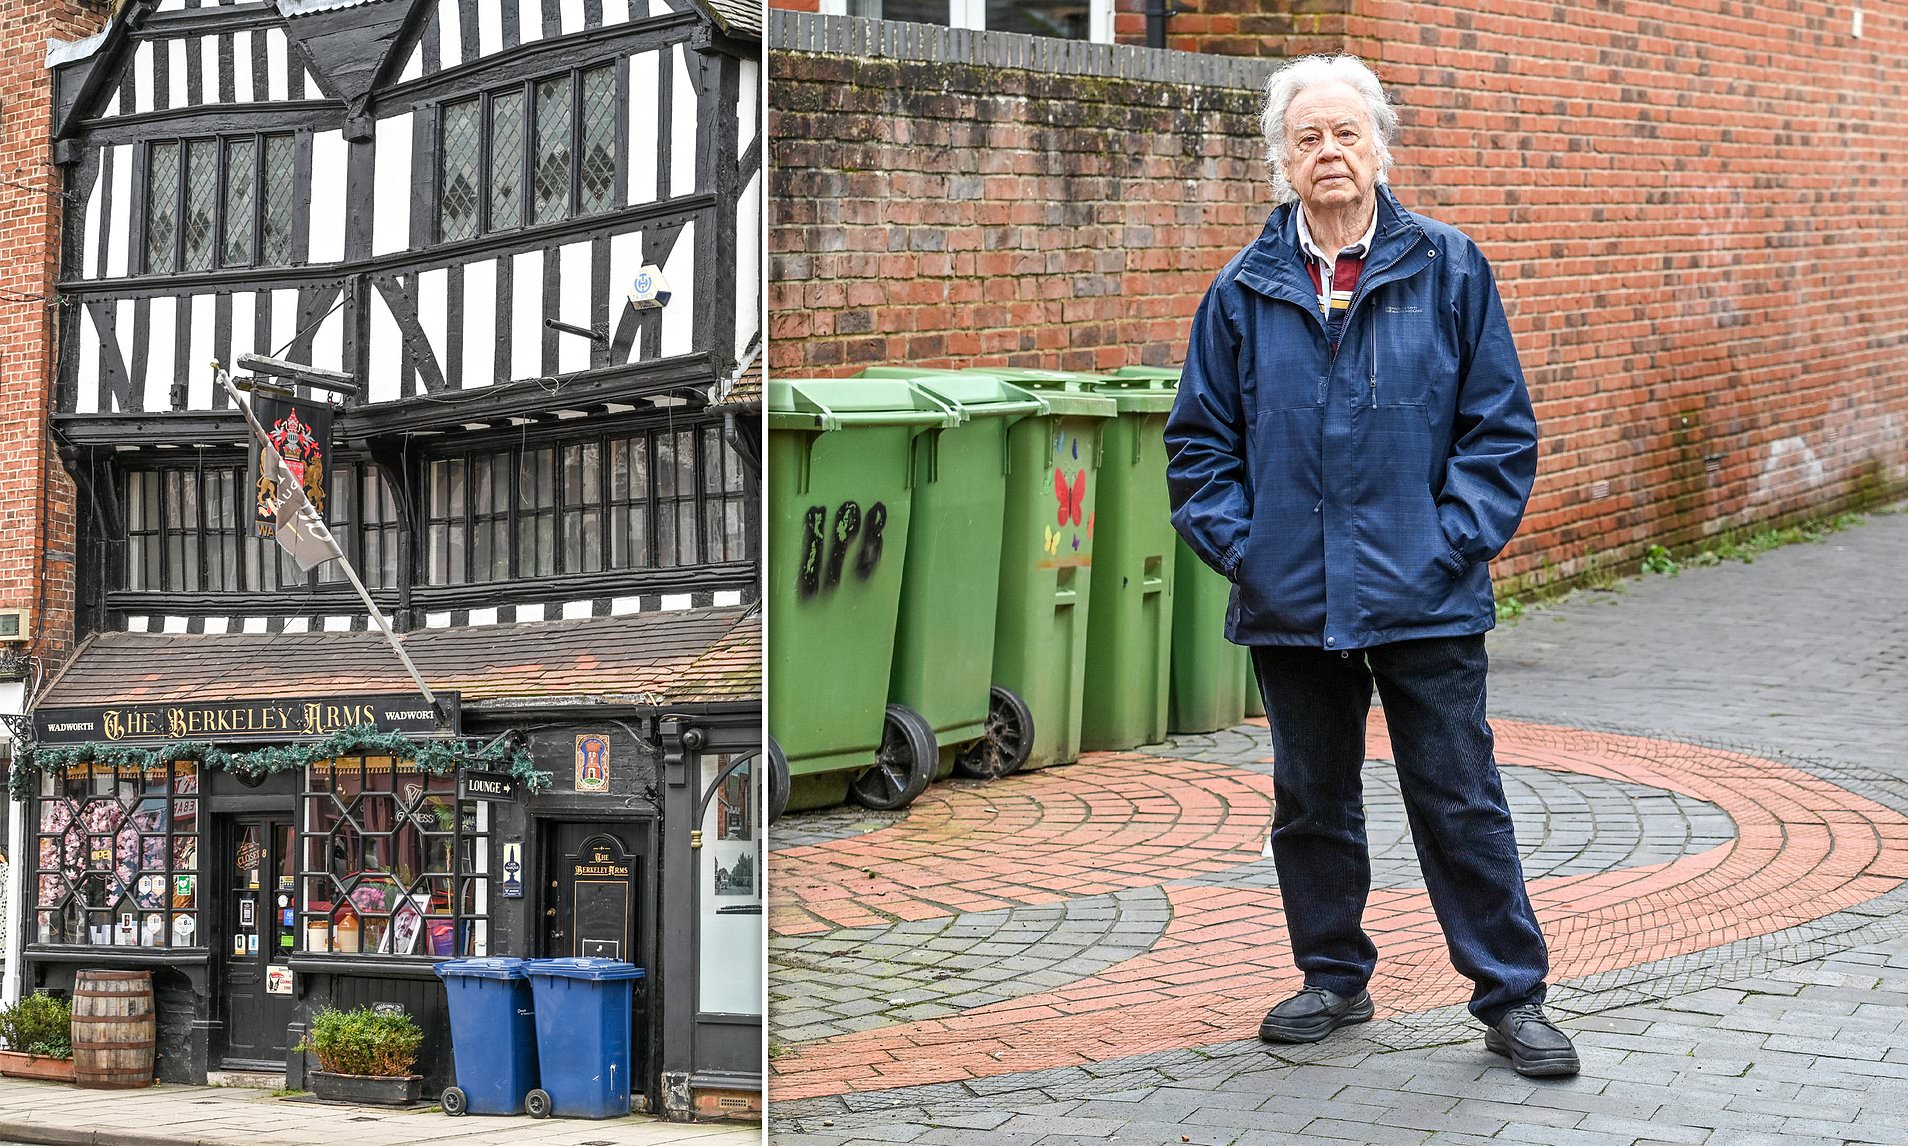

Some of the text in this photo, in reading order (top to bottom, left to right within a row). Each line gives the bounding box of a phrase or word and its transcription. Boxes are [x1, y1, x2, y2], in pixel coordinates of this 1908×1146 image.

[167, 706, 293, 738] BERKELEY
[302, 702, 375, 735] ARMS
[385, 710, 434, 721] WADWORT
[48, 722, 94, 732] WADWORTH
[469, 779, 501, 794] LOUNGE
[575, 865, 628, 875] BERKELEY ARMS
